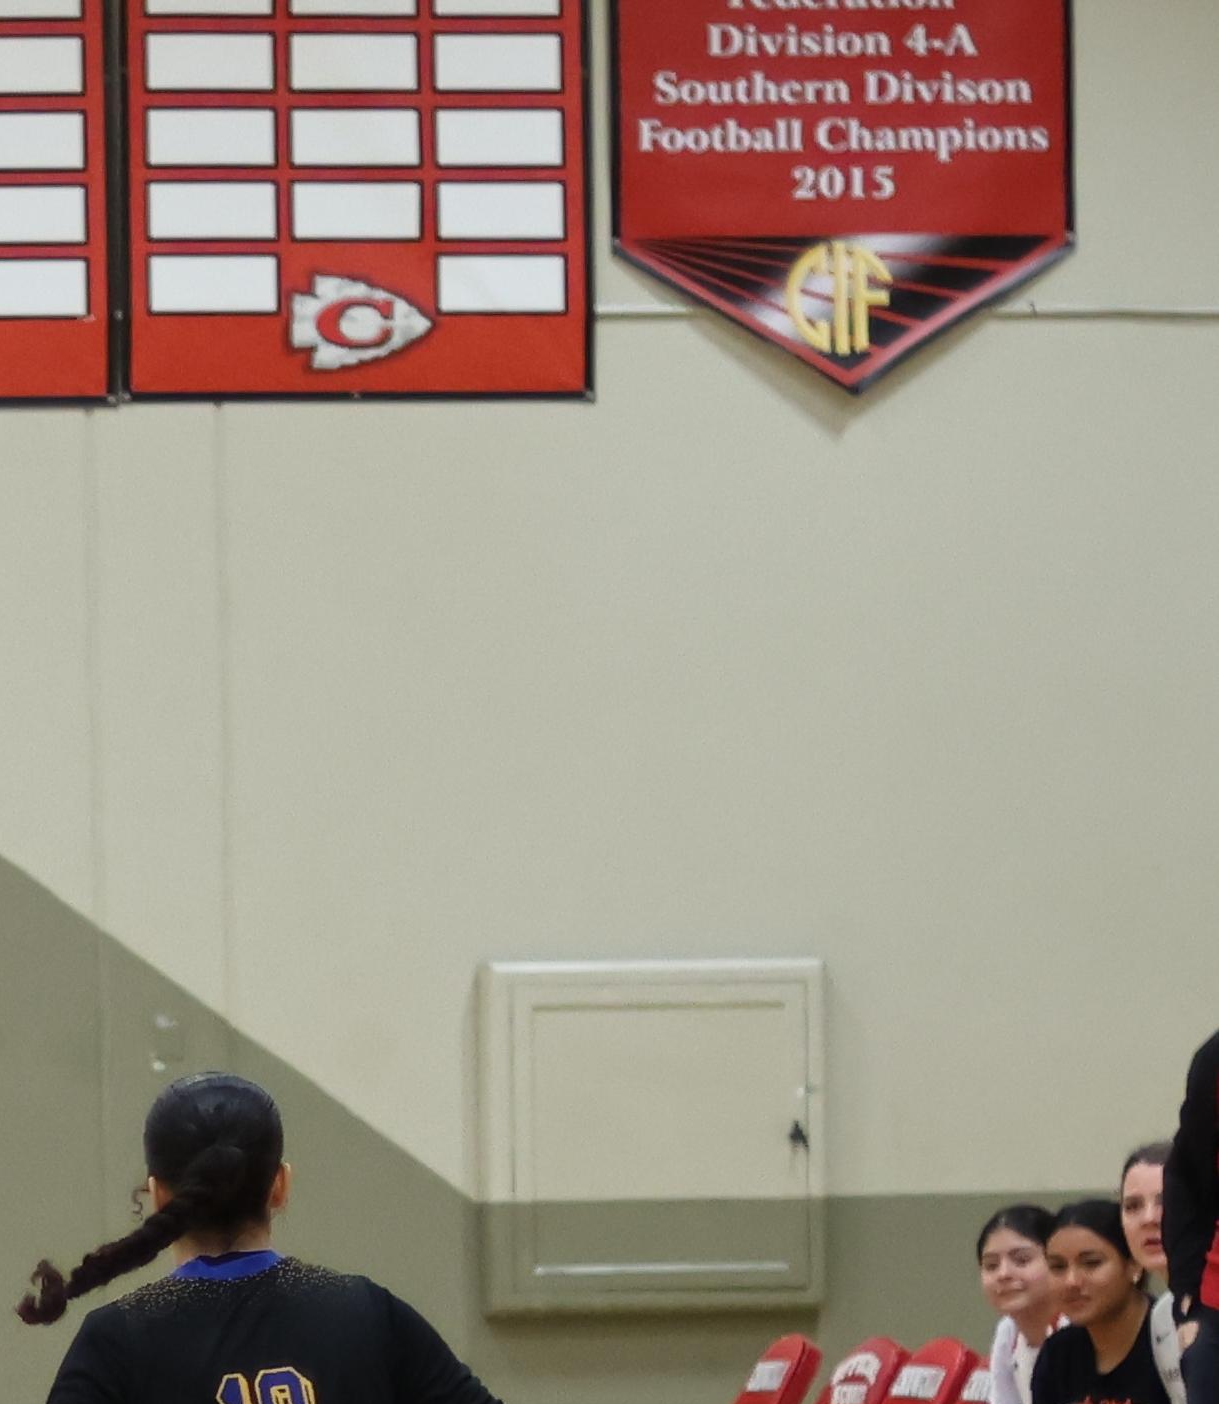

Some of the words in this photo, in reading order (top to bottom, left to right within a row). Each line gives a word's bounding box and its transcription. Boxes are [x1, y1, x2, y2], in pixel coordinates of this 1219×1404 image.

[707, 23, 893, 57] Division
[903, 23, 978, 57] 4-A
[652, 70, 851, 105] Southern
[864, 70, 1033, 105] Divison
[637, 118, 804, 153] Football
[815, 117, 1050, 162] Champions
[791, 165, 896, 200] 2015
[785, 240, 894, 356] CIF
[314, 297, 395, 350] C
